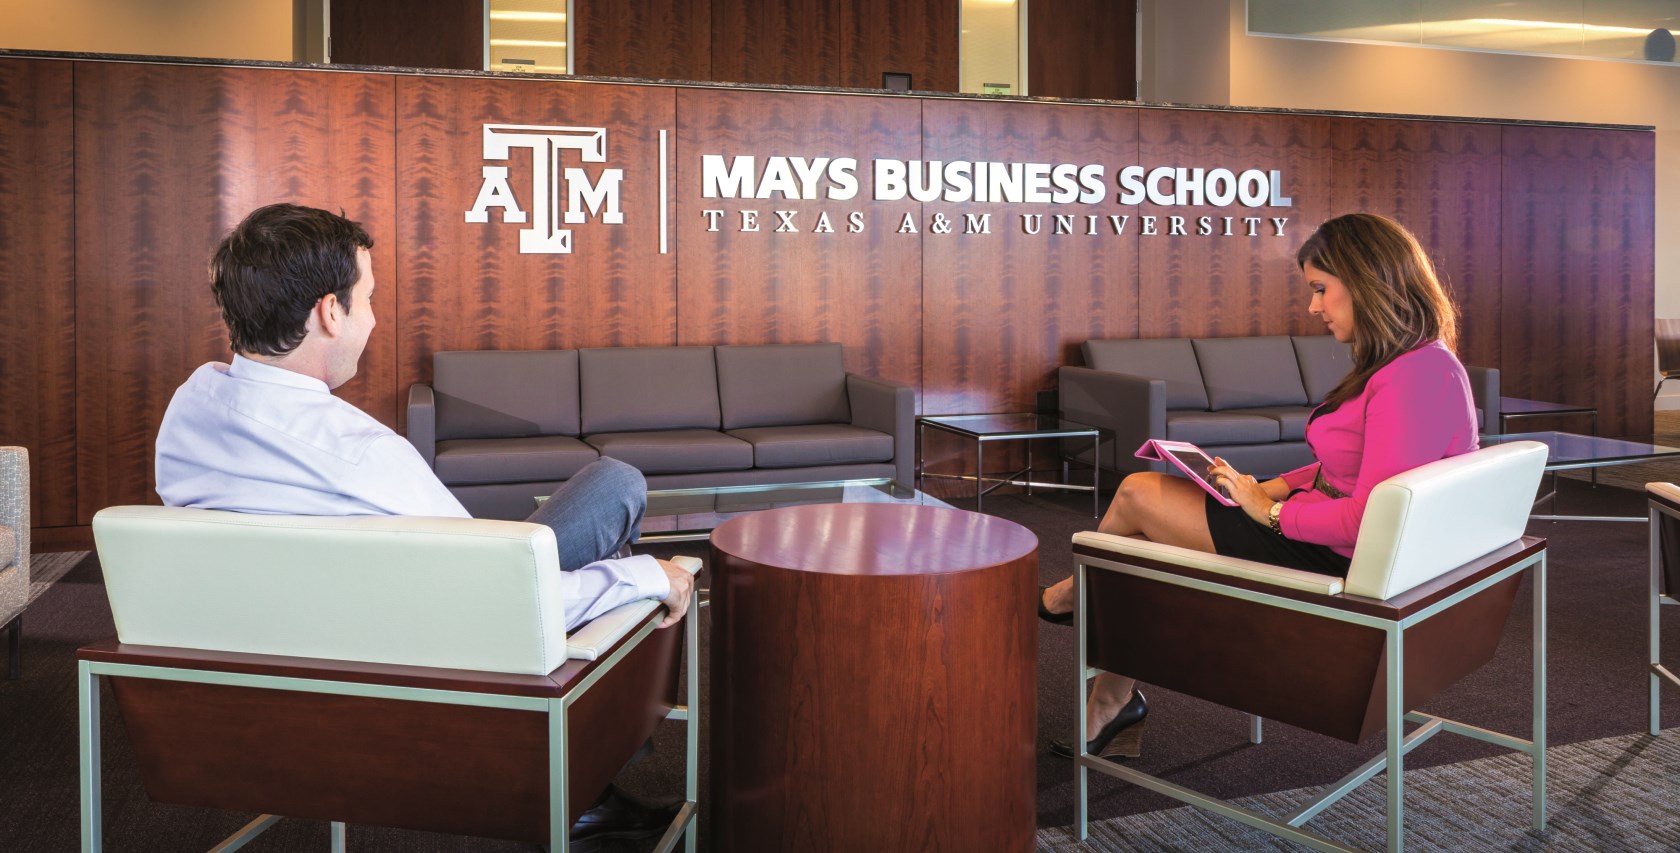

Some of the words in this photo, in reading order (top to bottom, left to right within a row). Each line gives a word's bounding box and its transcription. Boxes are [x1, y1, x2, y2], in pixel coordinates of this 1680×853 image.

[702, 154, 859, 201] MAYS
[873, 158, 1105, 204] BUSINESS
[1119, 165, 1292, 207] SCHOOL
[702, 209, 865, 234] TEXAS
[898, 212, 992, 235] A&M
[1021, 214, 1289, 237] UNIVERSITY
